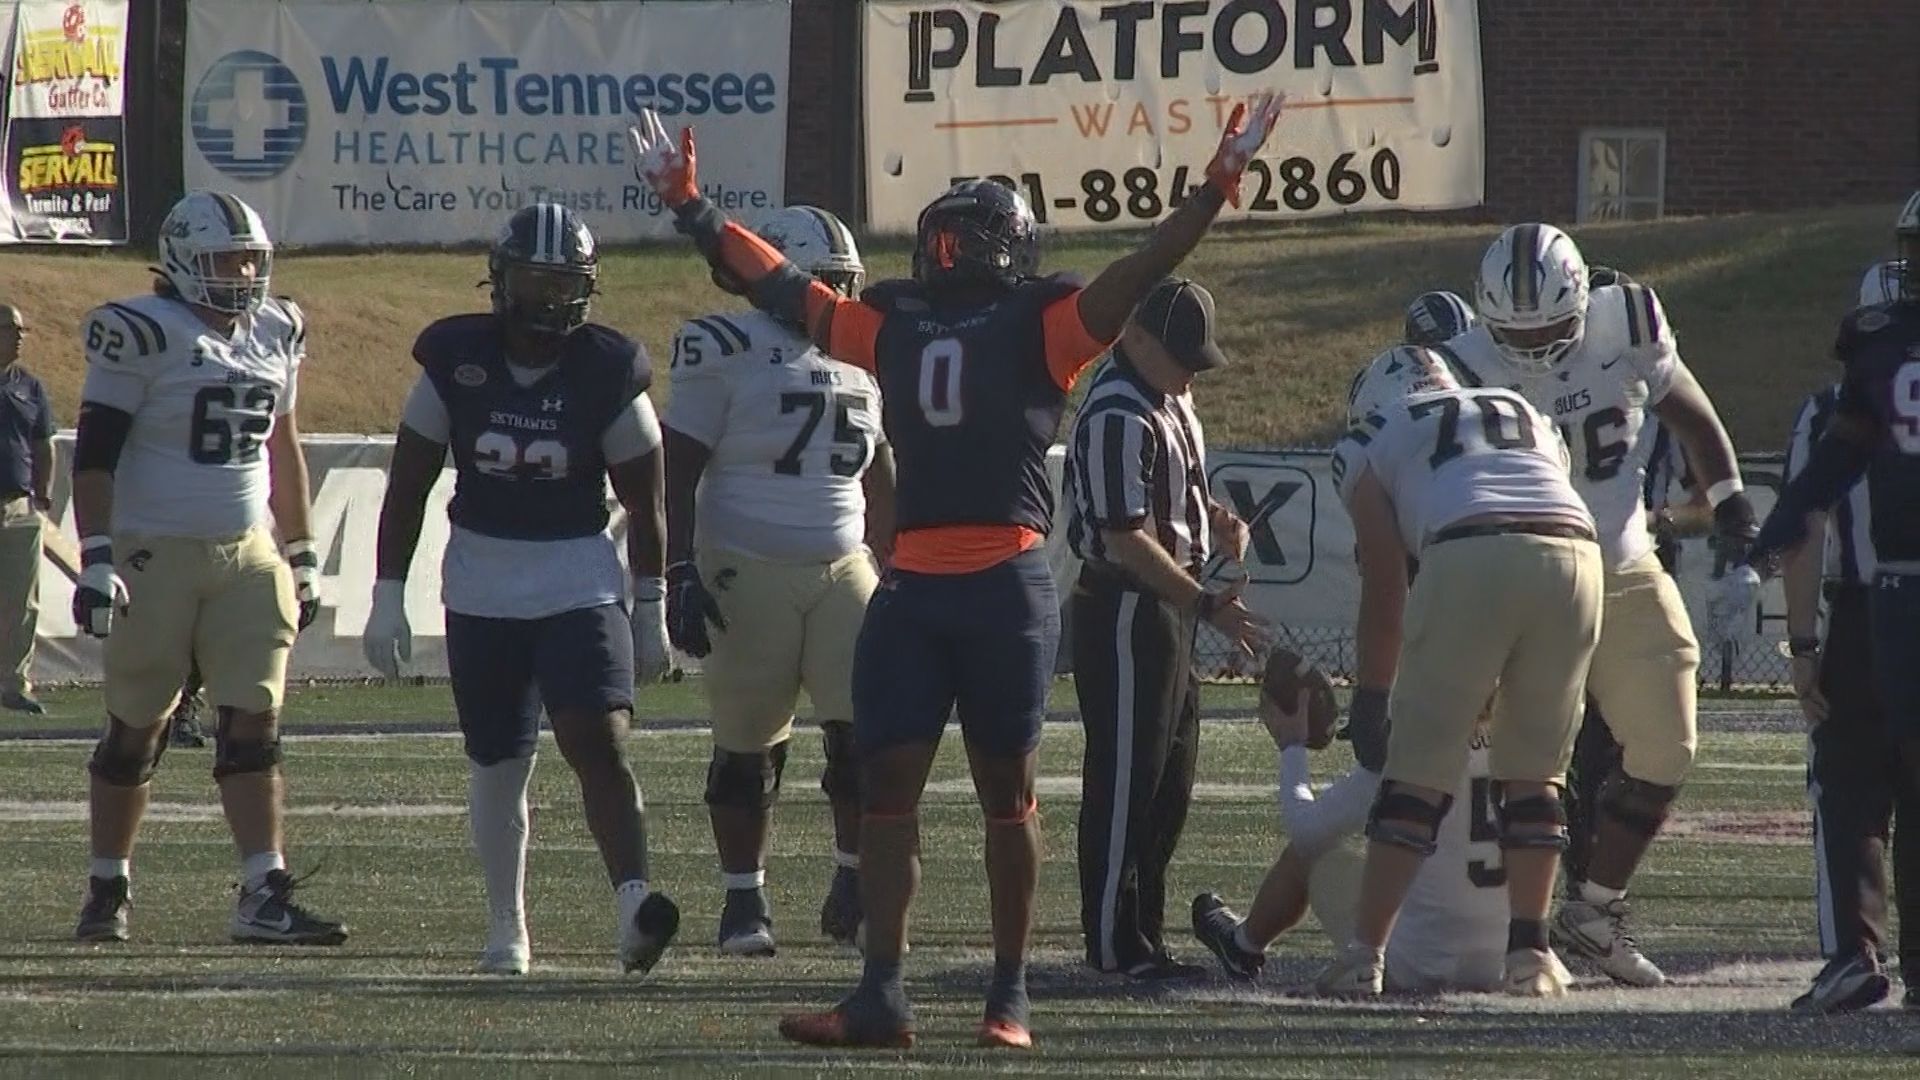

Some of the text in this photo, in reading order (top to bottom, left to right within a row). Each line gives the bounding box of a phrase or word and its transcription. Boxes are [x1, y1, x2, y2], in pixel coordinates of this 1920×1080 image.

[905, 0, 1439, 102] PLATFORM
[320, 56, 776, 116] West Tennessee
[1071, 93, 1262, 138] WAST
[333, 130, 625, 165] HEALTHCARE
[20, 152, 118, 192] SERVALL
[25, 191, 111, 213] Termite & Pest
[332, 184, 386, 211] The
[393, 185, 457, 211] Care
[467, 186, 521, 211] You
[86, 319, 124, 362] 62
[918, 338, 963, 427] 0
[1555, 389, 1592, 416] BUCS
[189, 386, 276, 465] 62
[490, 410, 558, 431] SKYHAWKS
[774, 391, 870, 478] 75
[1407, 396, 1537, 471] 70
